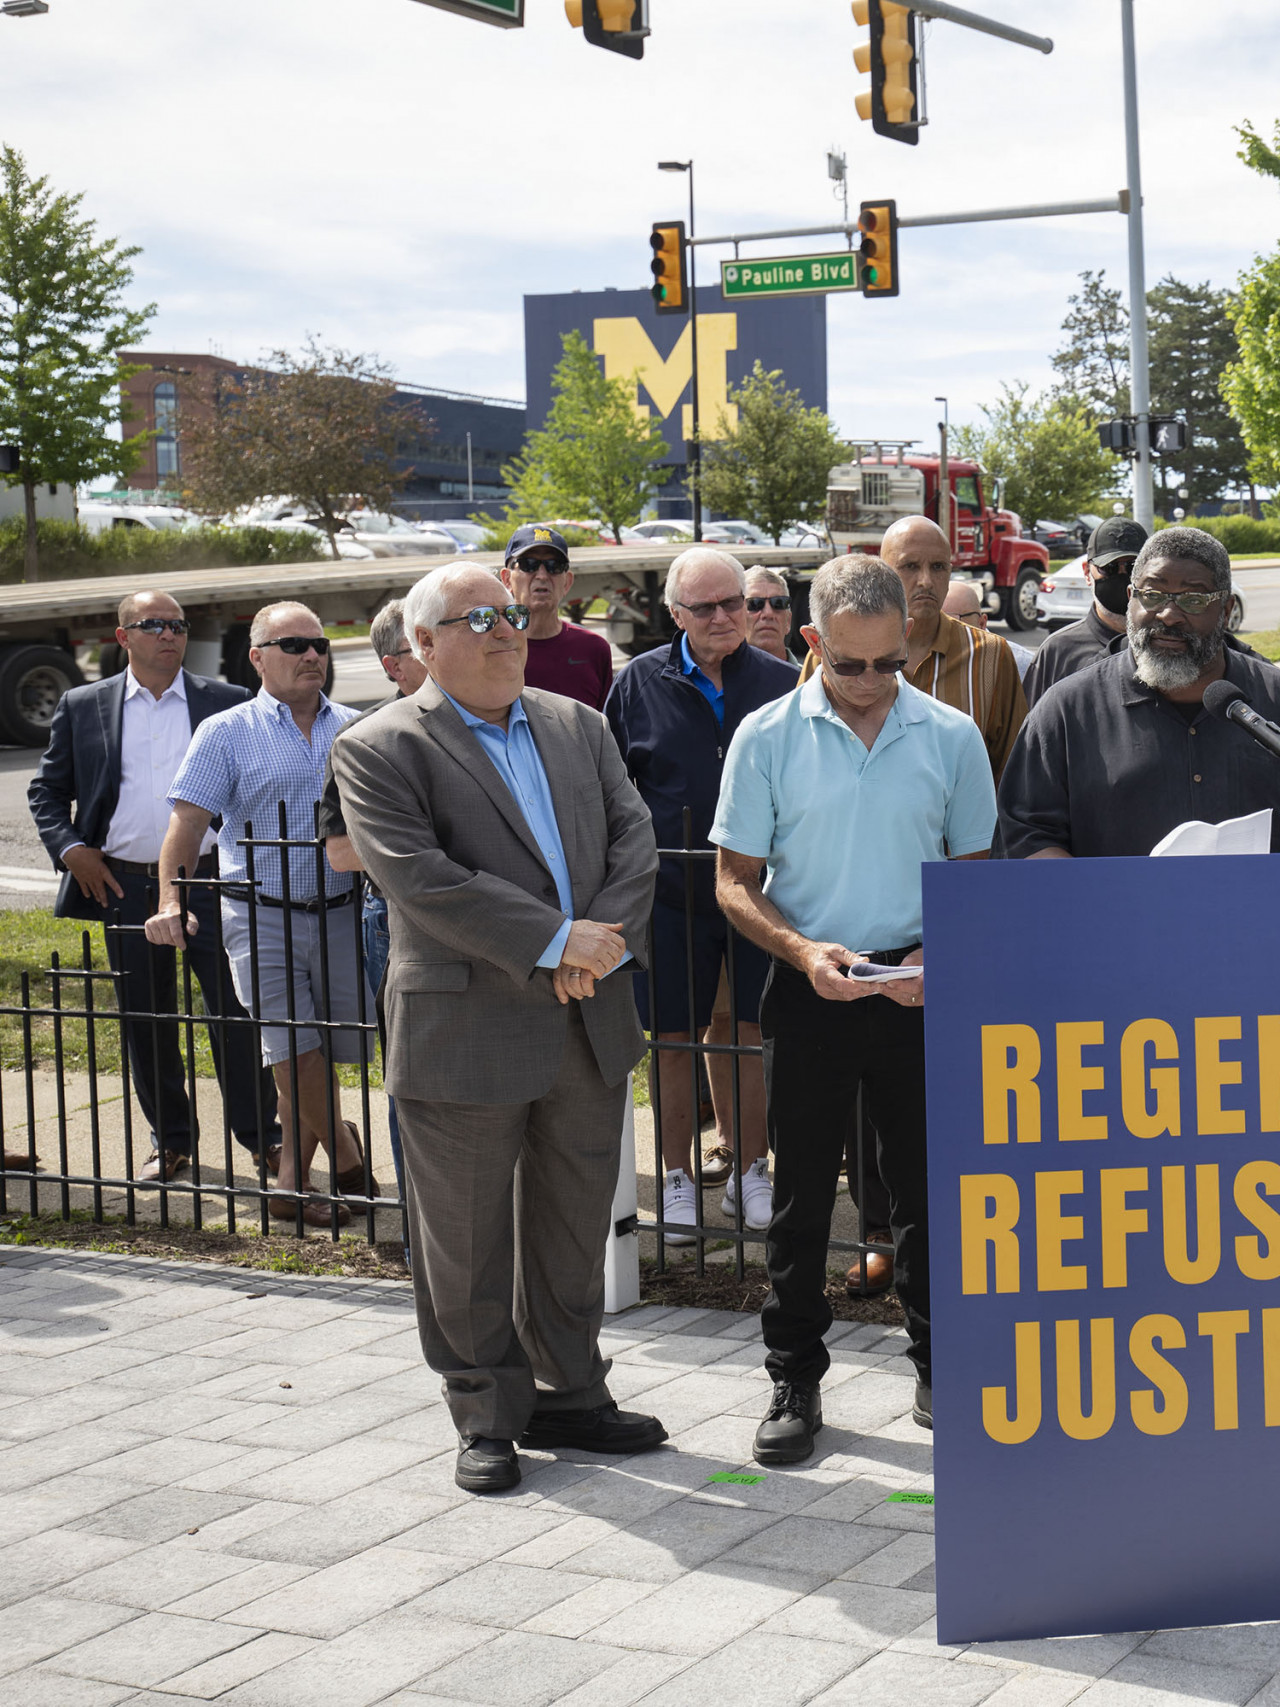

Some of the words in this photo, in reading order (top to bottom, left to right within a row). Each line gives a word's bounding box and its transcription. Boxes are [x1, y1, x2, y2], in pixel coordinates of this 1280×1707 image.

[741, 266, 804, 286] Pauline
[811, 261, 850, 281] Blvd
[594, 313, 739, 441] M
